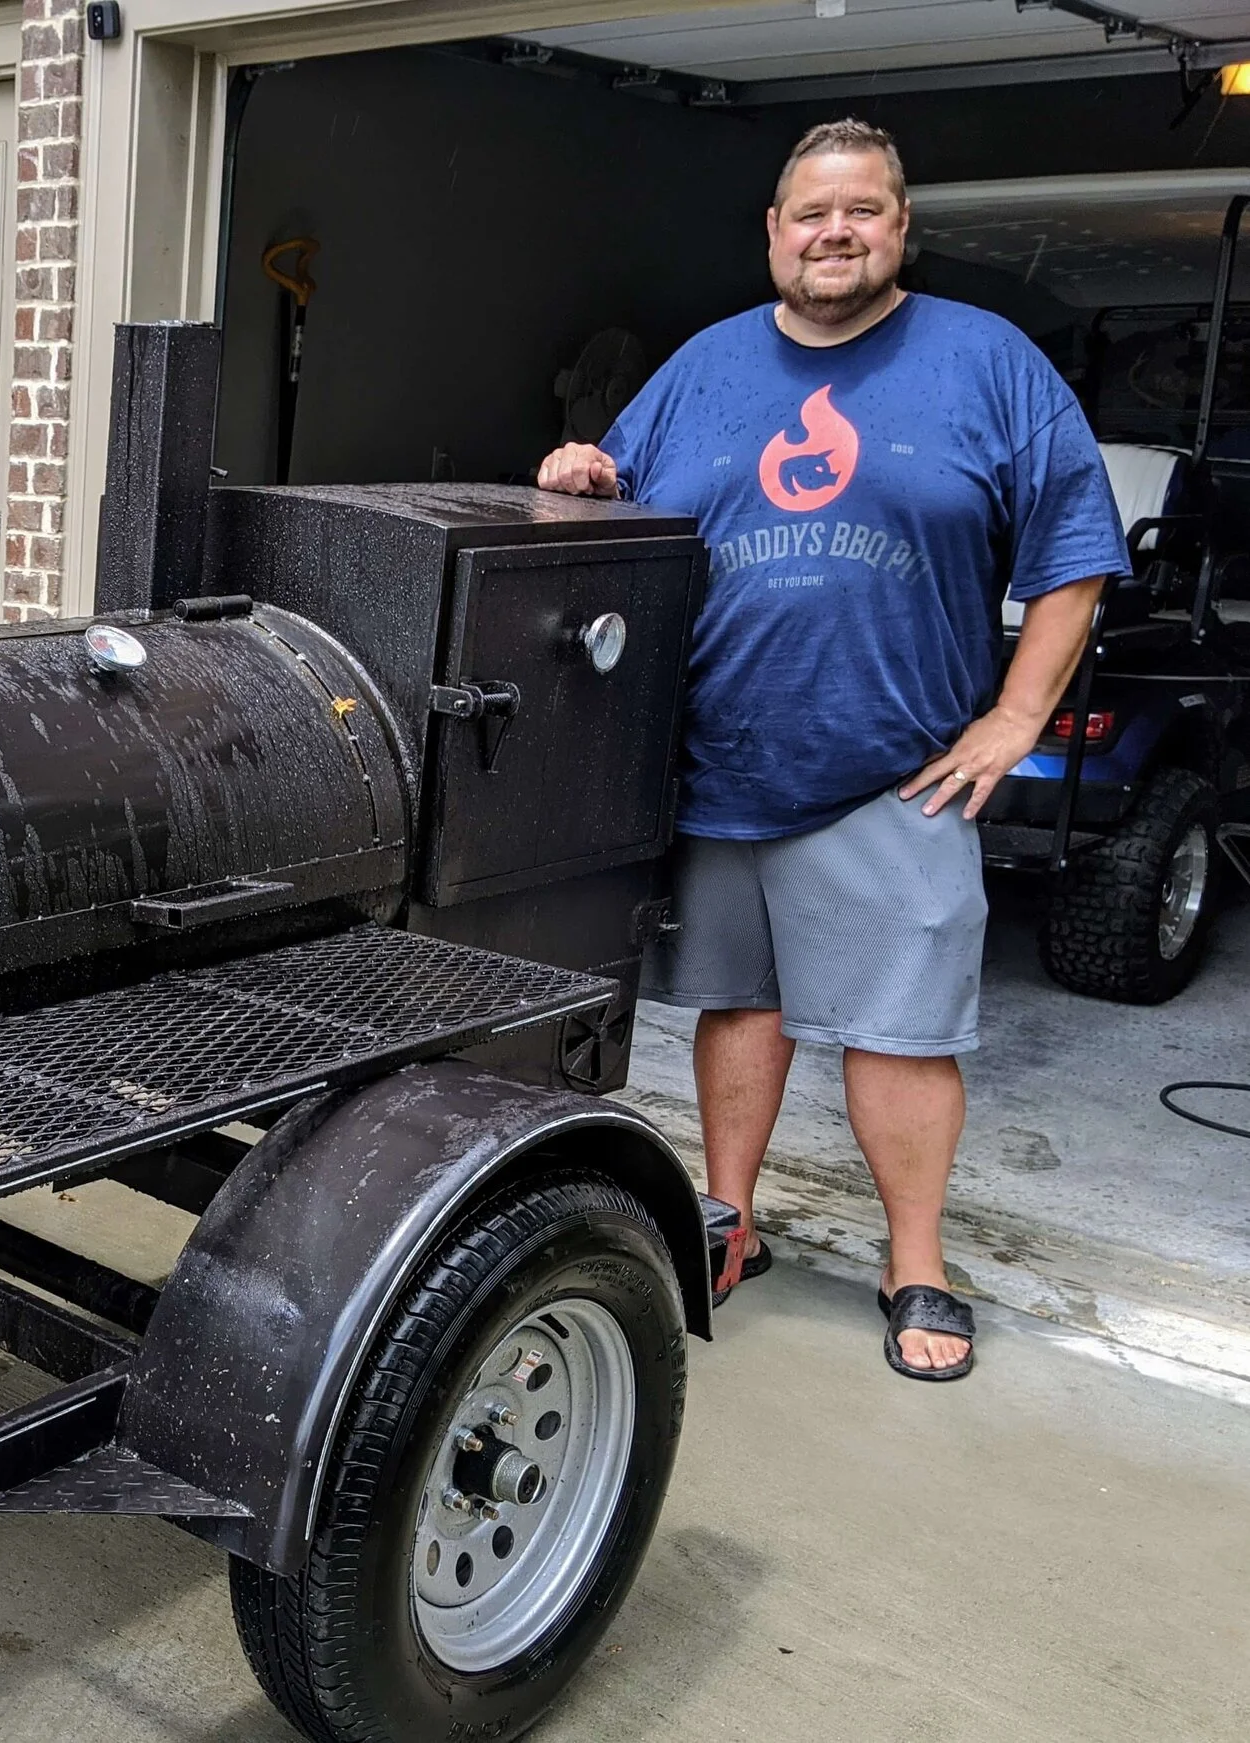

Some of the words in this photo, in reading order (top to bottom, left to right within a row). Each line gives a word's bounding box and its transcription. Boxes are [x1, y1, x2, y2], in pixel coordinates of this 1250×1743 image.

[719, 521, 826, 575] DADDYS
[829, 521, 888, 569] BBQ
[784, 576, 800, 588] YOU
[802, 575, 824, 586] SOME
[668, 1326, 688, 1440] KENDA
